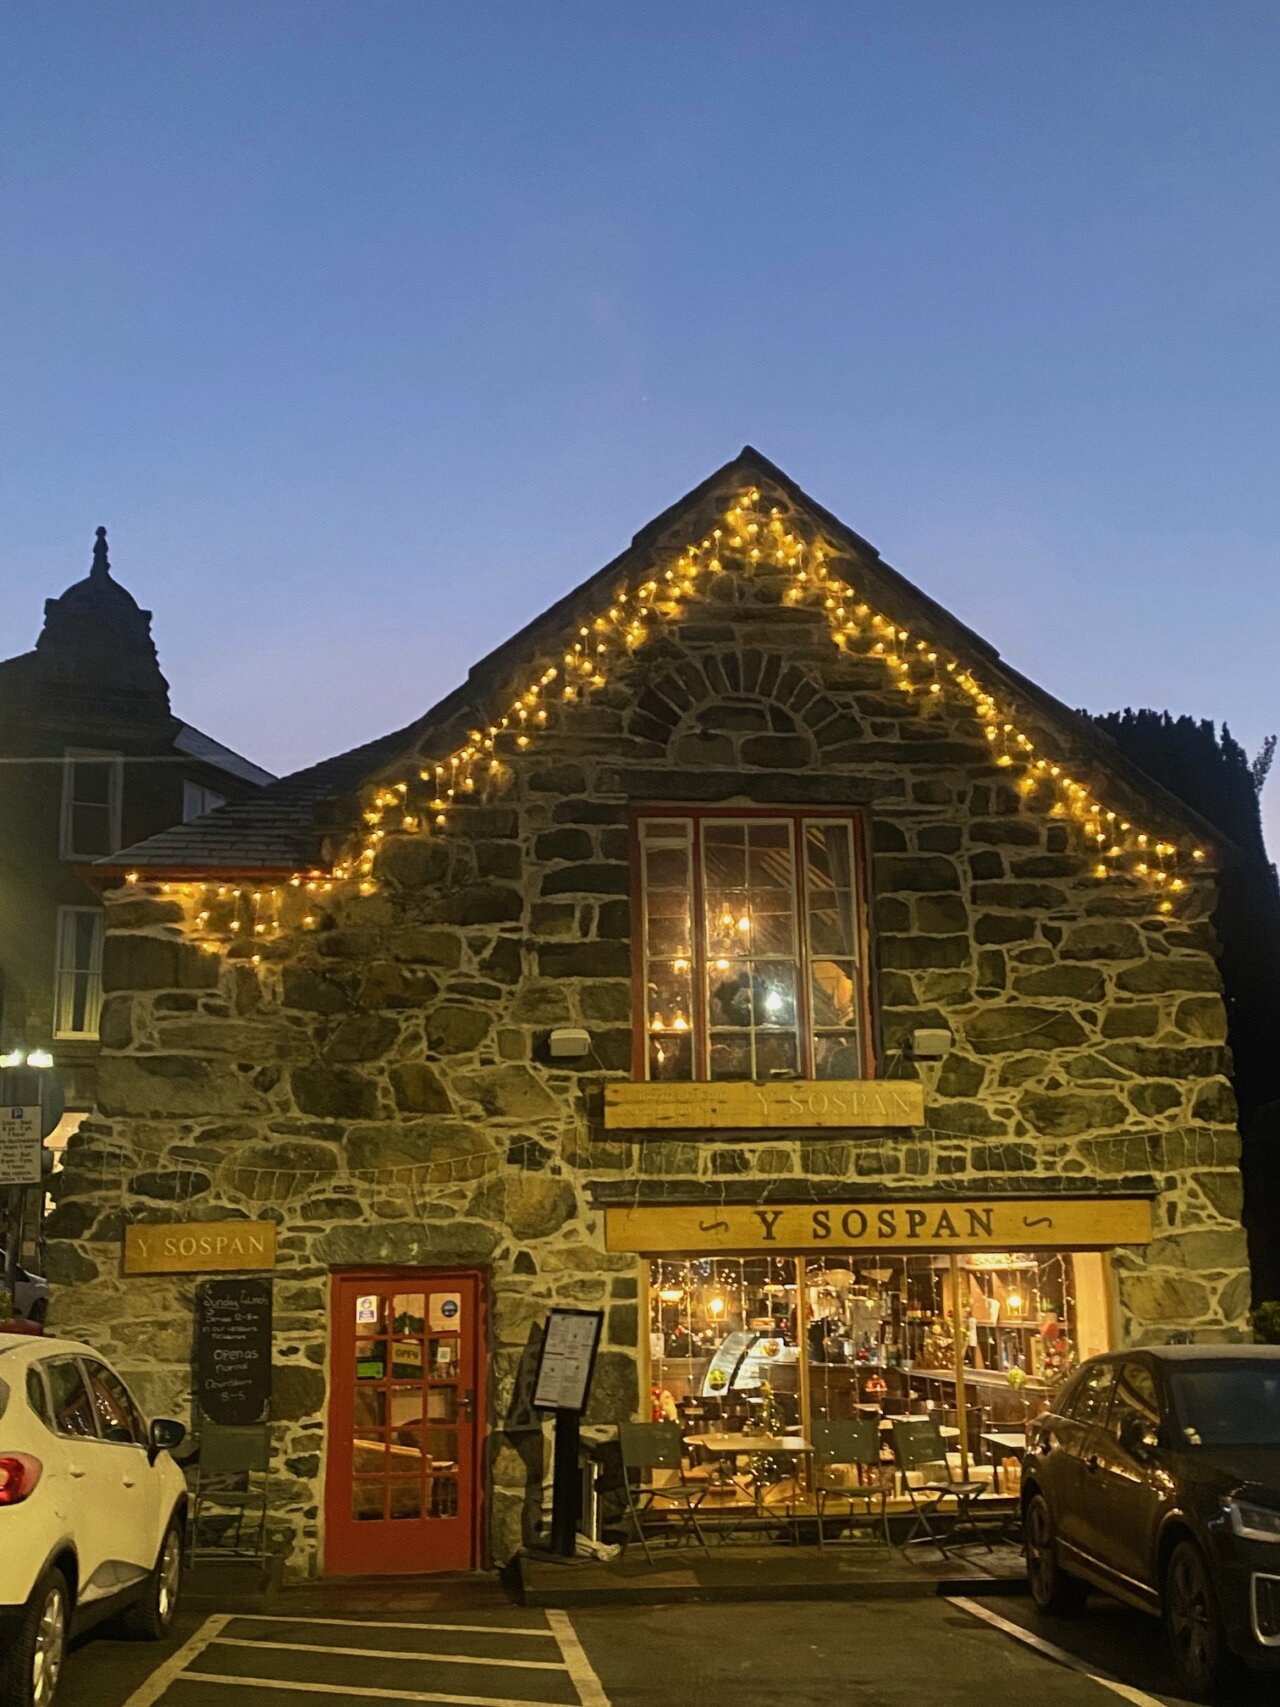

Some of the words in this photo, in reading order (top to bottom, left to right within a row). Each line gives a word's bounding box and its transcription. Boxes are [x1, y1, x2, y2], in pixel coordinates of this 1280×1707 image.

[756, 1091, 776, 1115] Y
[789, 1091, 911, 1115] SOSPAN
[754, 1210, 784, 1240] Y
[812, 1208, 994, 1240] SOSPAN
[137, 1238, 152, 1257] Y
[164, 1235, 264, 1256] SOSPAN
[203, 1286, 239, 1310] Sunday
[395, 1349, 419, 1360] OPEN
